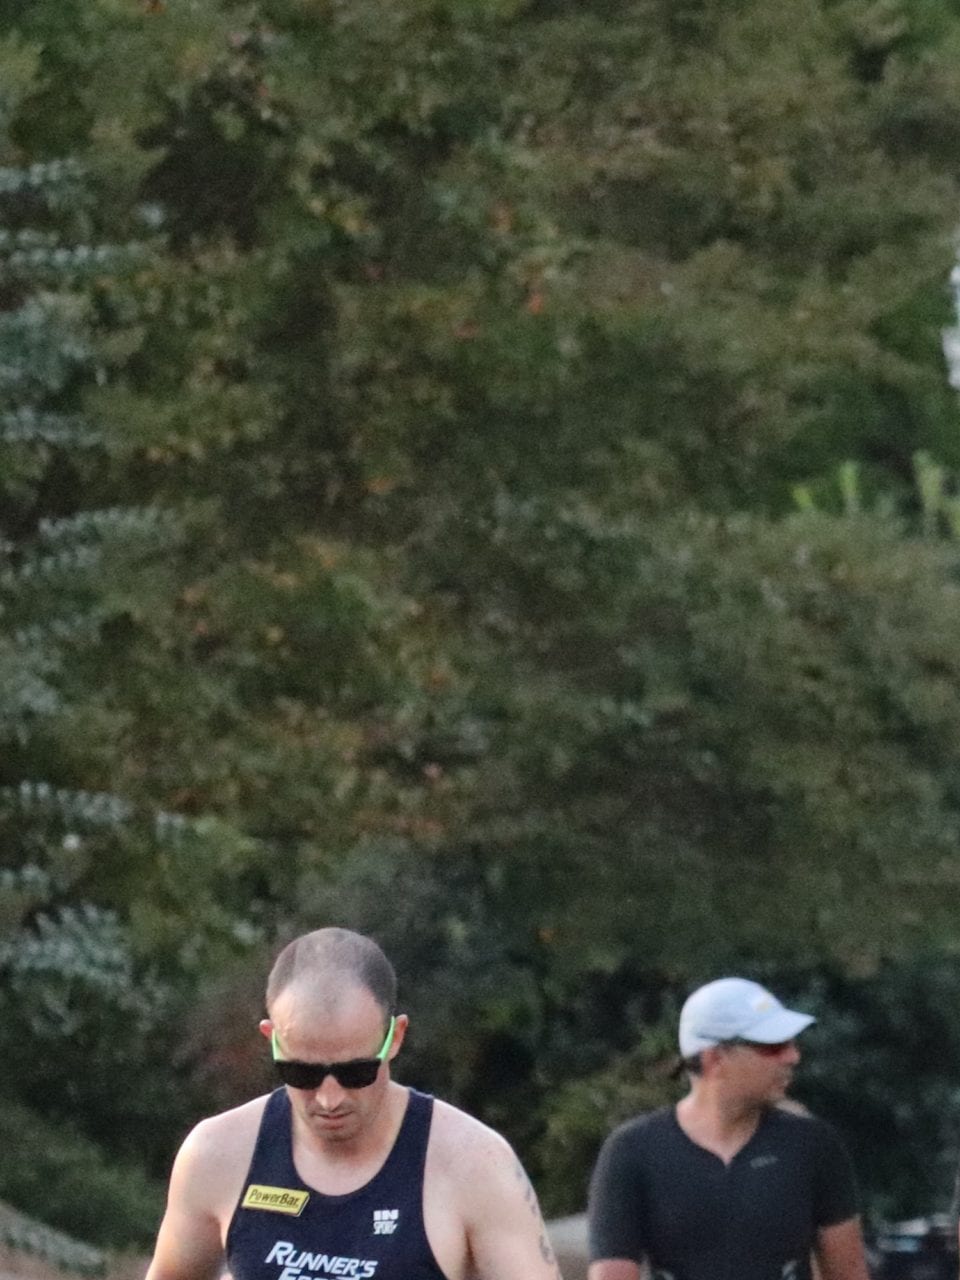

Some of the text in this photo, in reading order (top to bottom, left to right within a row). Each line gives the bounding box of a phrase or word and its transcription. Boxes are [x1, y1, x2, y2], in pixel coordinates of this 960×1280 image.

[249, 1189, 300, 1206] PowerBar
[373, 1209, 399, 1221] IN
[265, 1241, 378, 1278] RUNNER'S
